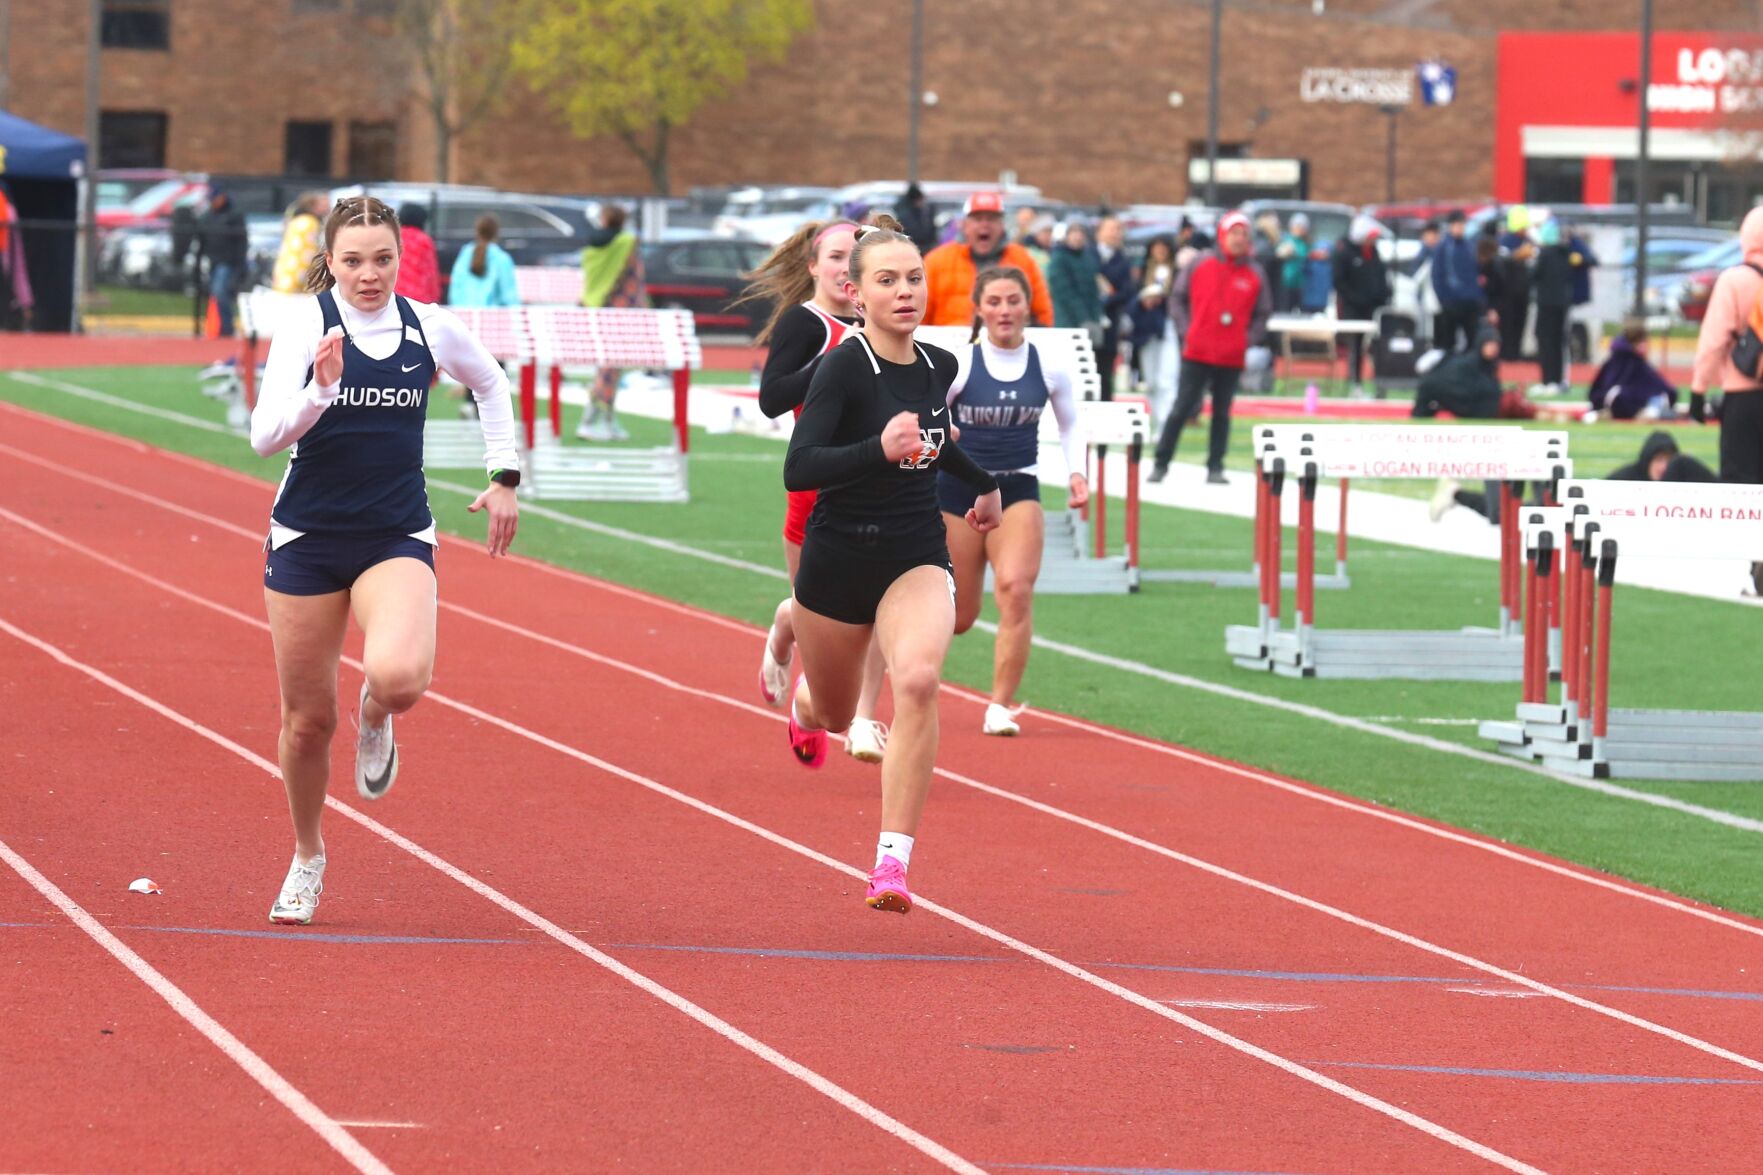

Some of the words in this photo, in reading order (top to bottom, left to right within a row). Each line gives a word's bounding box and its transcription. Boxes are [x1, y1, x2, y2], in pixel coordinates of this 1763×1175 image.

[332, 387, 423, 408] HUDSON
[1362, 460, 1422, 476] LOGAN
[1427, 462, 1508, 478] RANGERS
